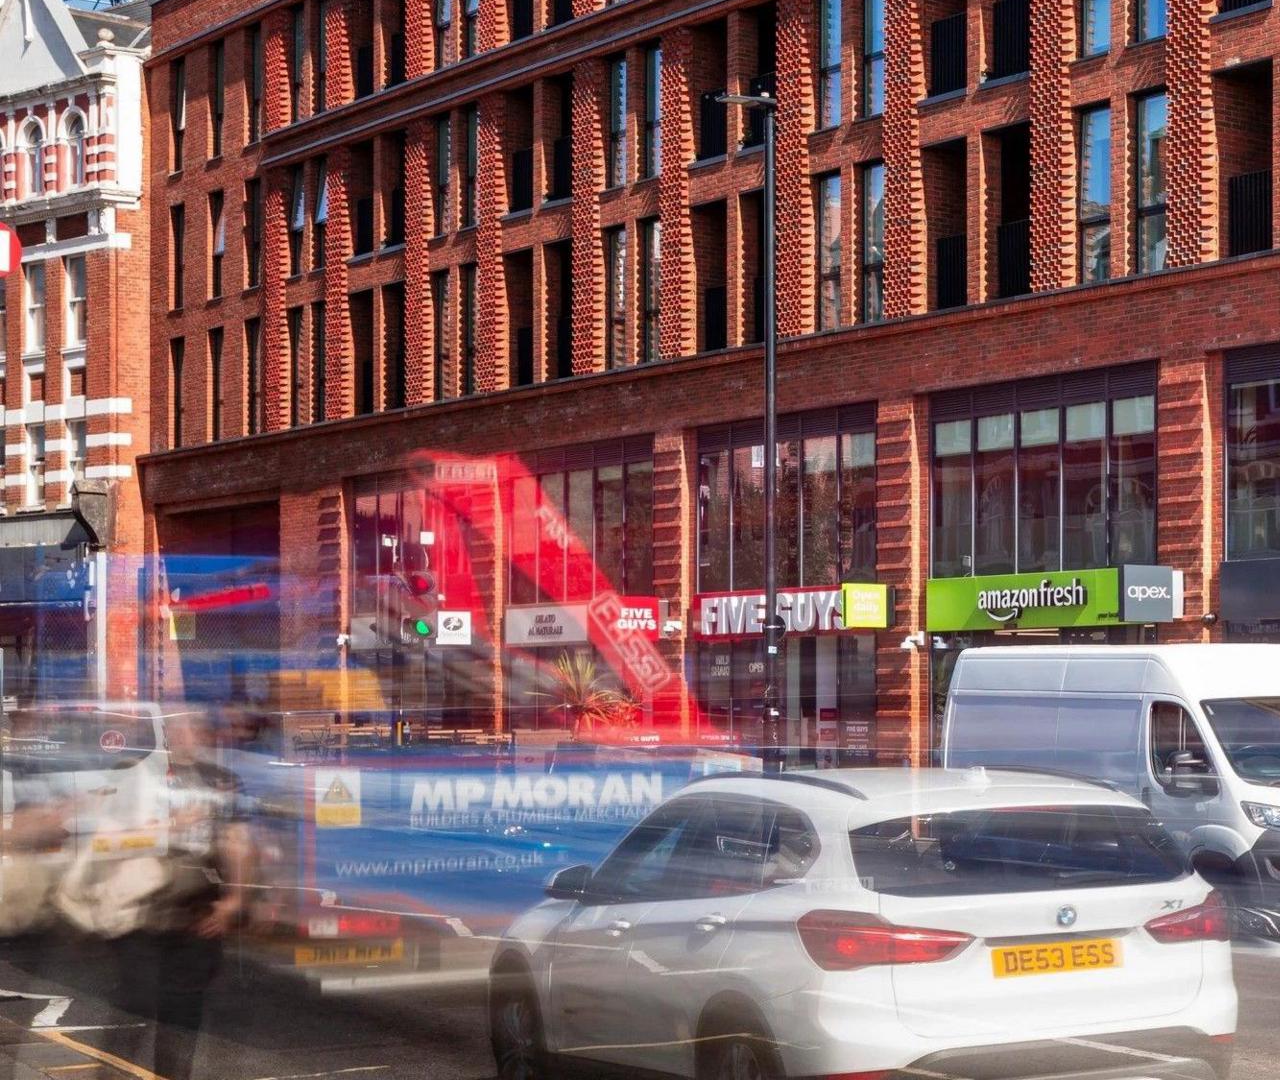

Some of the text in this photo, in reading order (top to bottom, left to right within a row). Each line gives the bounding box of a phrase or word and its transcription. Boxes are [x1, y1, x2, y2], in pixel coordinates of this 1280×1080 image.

[1127, 585, 1171, 602] apex.
[617, 618, 657, 630] GUYS
[620, 607, 653, 619] FIVE
[700, 594, 767, 636] FIVE
[410, 771, 663, 814] MP MORAN
[335, 849, 543, 879] www.mpmoran.co.uk
[1161, 899, 1183, 910] X1
[1002, 942, 1115, 974] DE53 ESS
